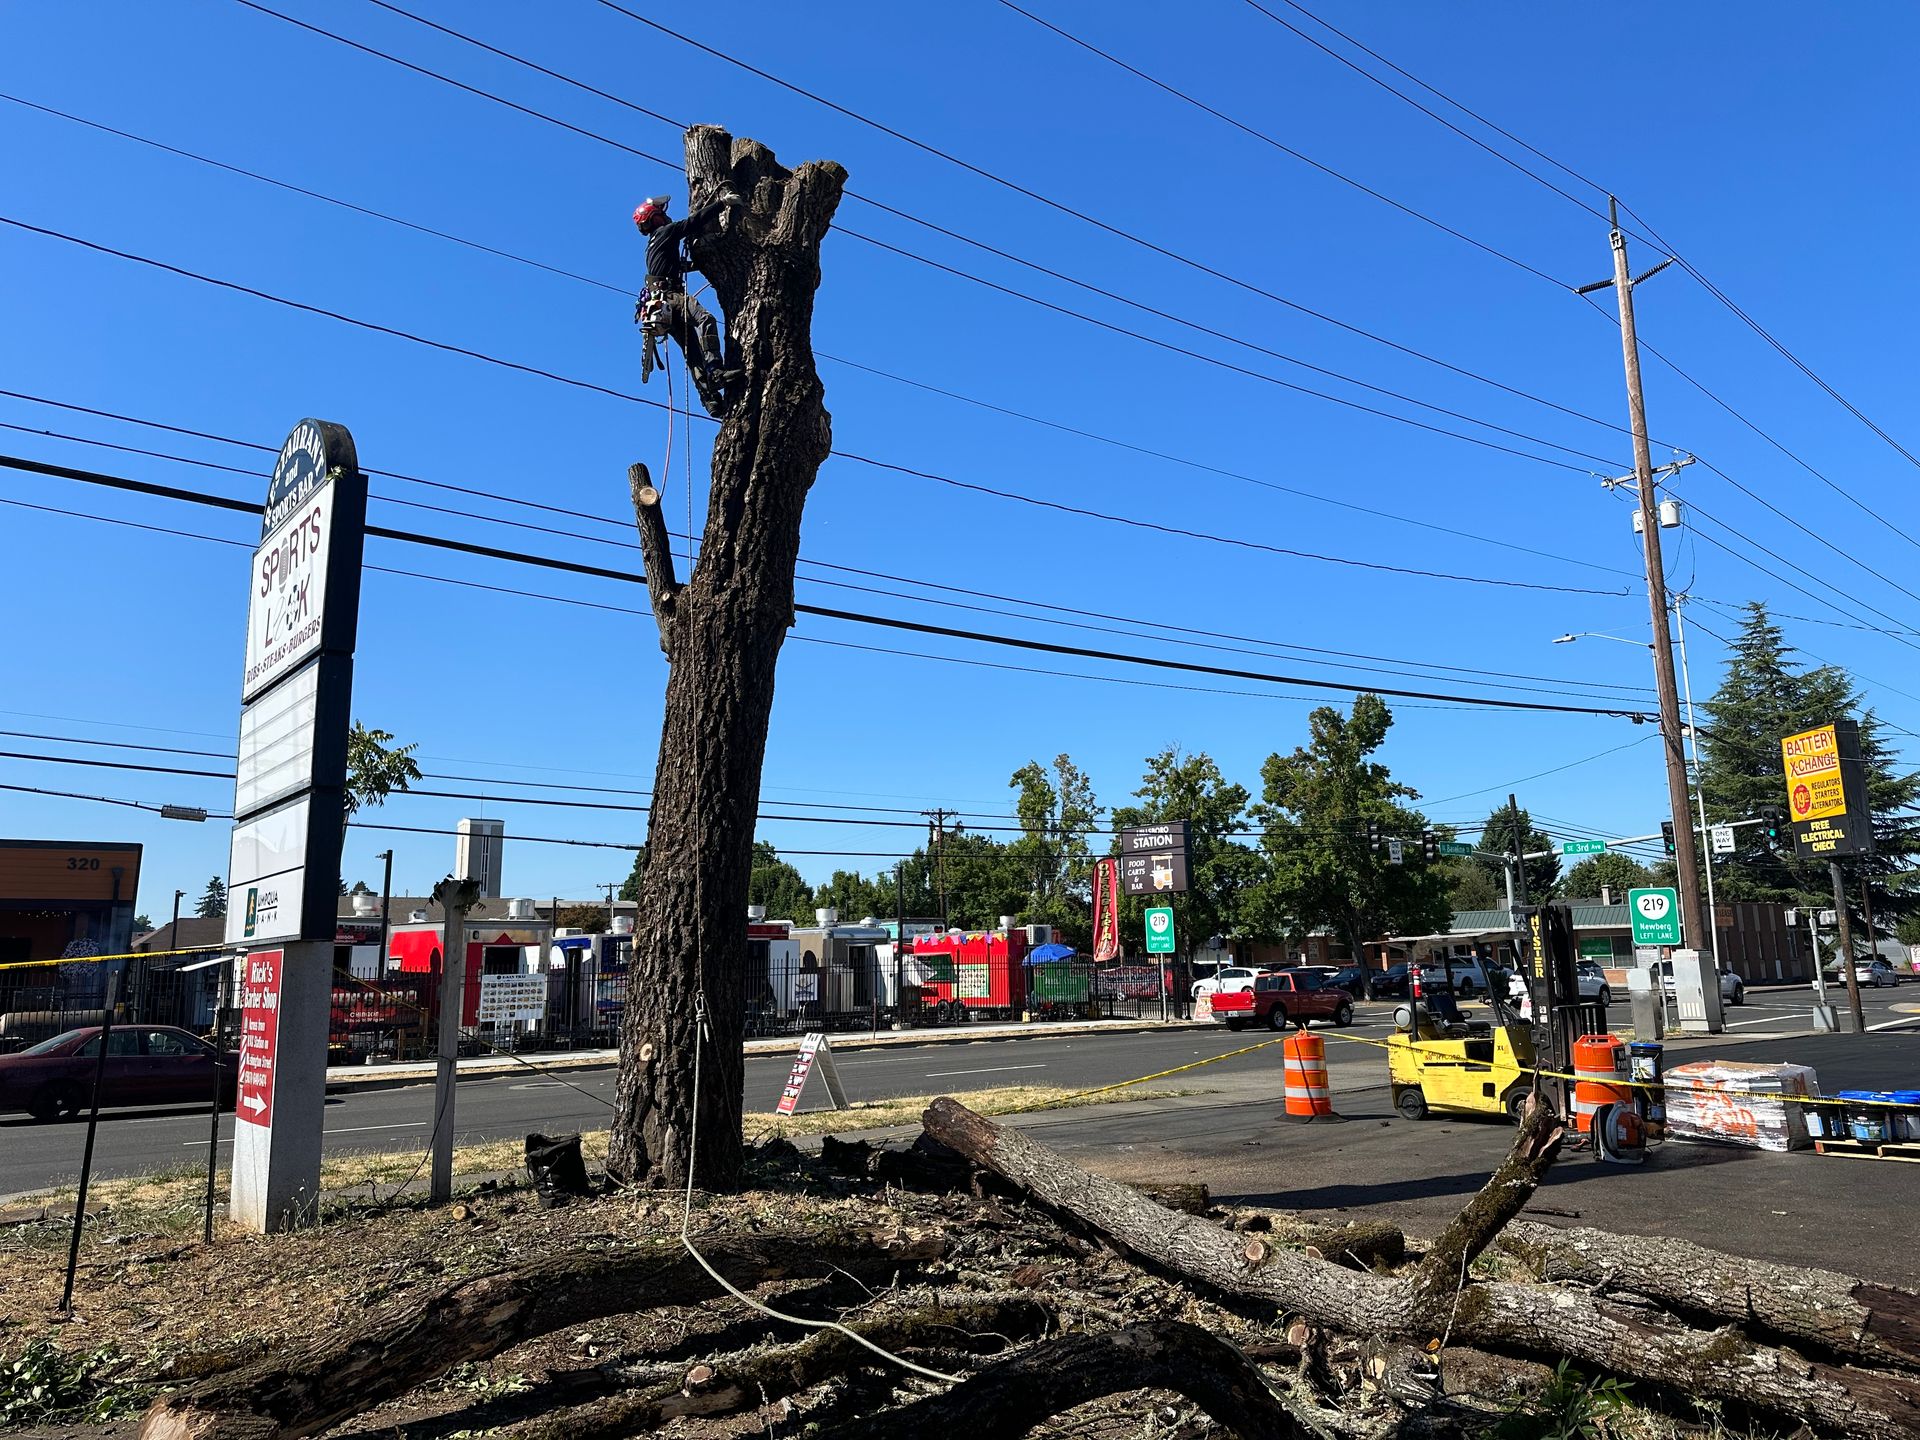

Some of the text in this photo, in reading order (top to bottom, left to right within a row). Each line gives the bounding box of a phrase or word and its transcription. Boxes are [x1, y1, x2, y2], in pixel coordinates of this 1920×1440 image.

[264, 425, 325, 529] RESTAURANT
[284, 458, 299, 487] and
[271, 471, 314, 528] SPORTS BAR
[1786, 731, 1835, 756] BATTERY
[1790, 752, 1837, 778] X-CHANGE
[1811, 778, 1841, 790] REGULATORS
[1815, 788, 1840, 800] STARTERS
[1811, 797, 1844, 810] ALTERNATORS
[1810, 820, 1830, 831] FREE
[1133, 834, 1173, 849] STATION
[1800, 829, 1845, 843] ELECTRICAL
[1577, 844, 1589, 852] 3rd
[1812, 840, 1836, 852] CHECK
[67, 857, 100, 871] 320
[1128, 860, 1146, 868] FOOD
[1127, 868, 1146, 876] CARTS
[258, 891, 278, 907] UMPQUA
[1643, 898, 1664, 911] 219
[1153, 916, 1166, 926] 219
[1640, 923, 1672, 932] Newberg
[1530, 915, 1545, 978] HYSTER
[251, 961, 273, 983] Rick's
[245, 986, 277, 1014] Barber Shop
